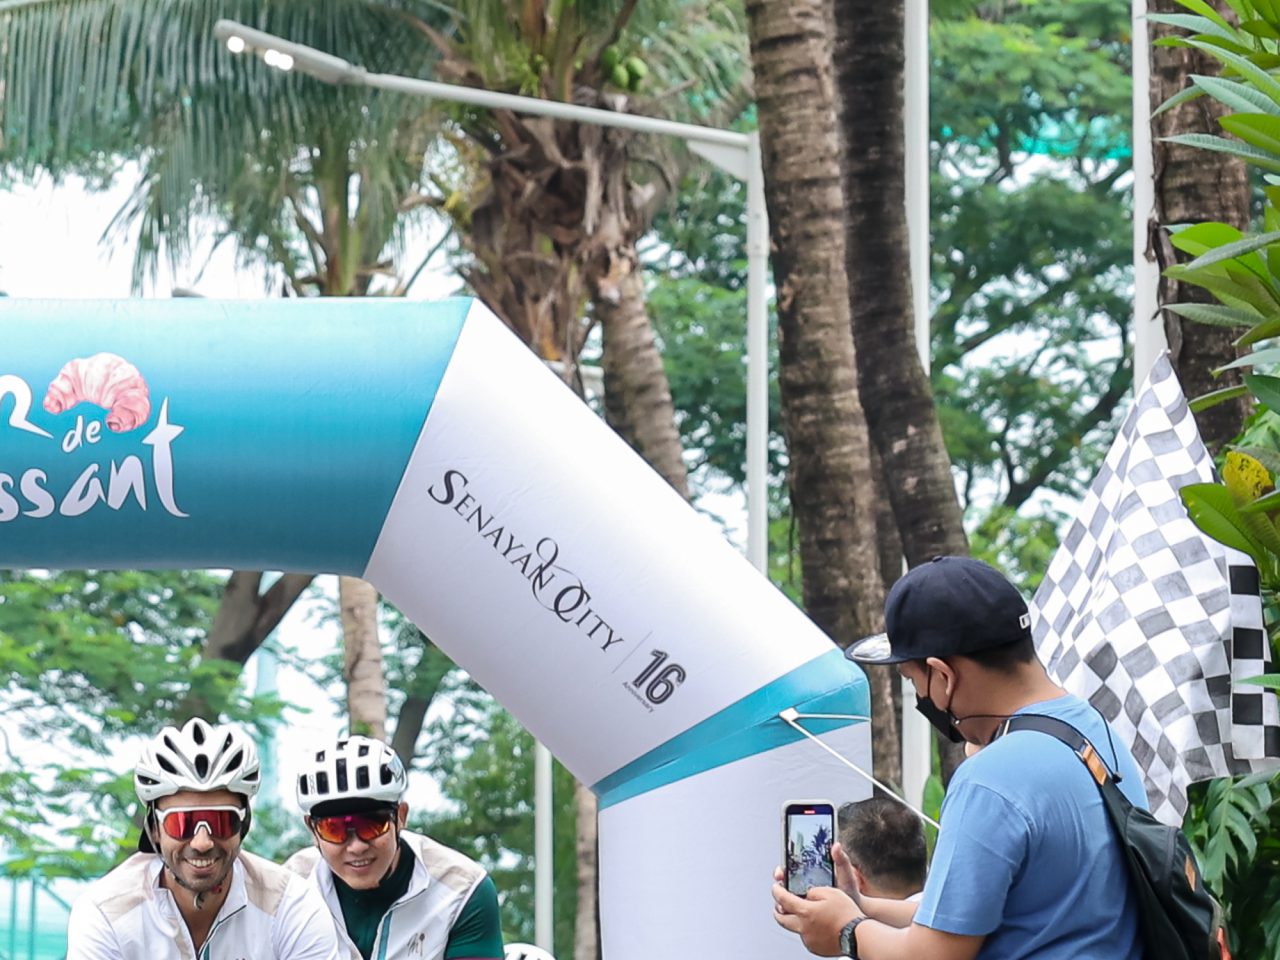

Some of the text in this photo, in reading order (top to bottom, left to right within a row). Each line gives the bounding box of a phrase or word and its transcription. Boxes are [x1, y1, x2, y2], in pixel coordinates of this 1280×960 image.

[62, 414, 102, 453] de
[631, 648, 688, 706] 16
[622, 680, 656, 714] Anniversary
